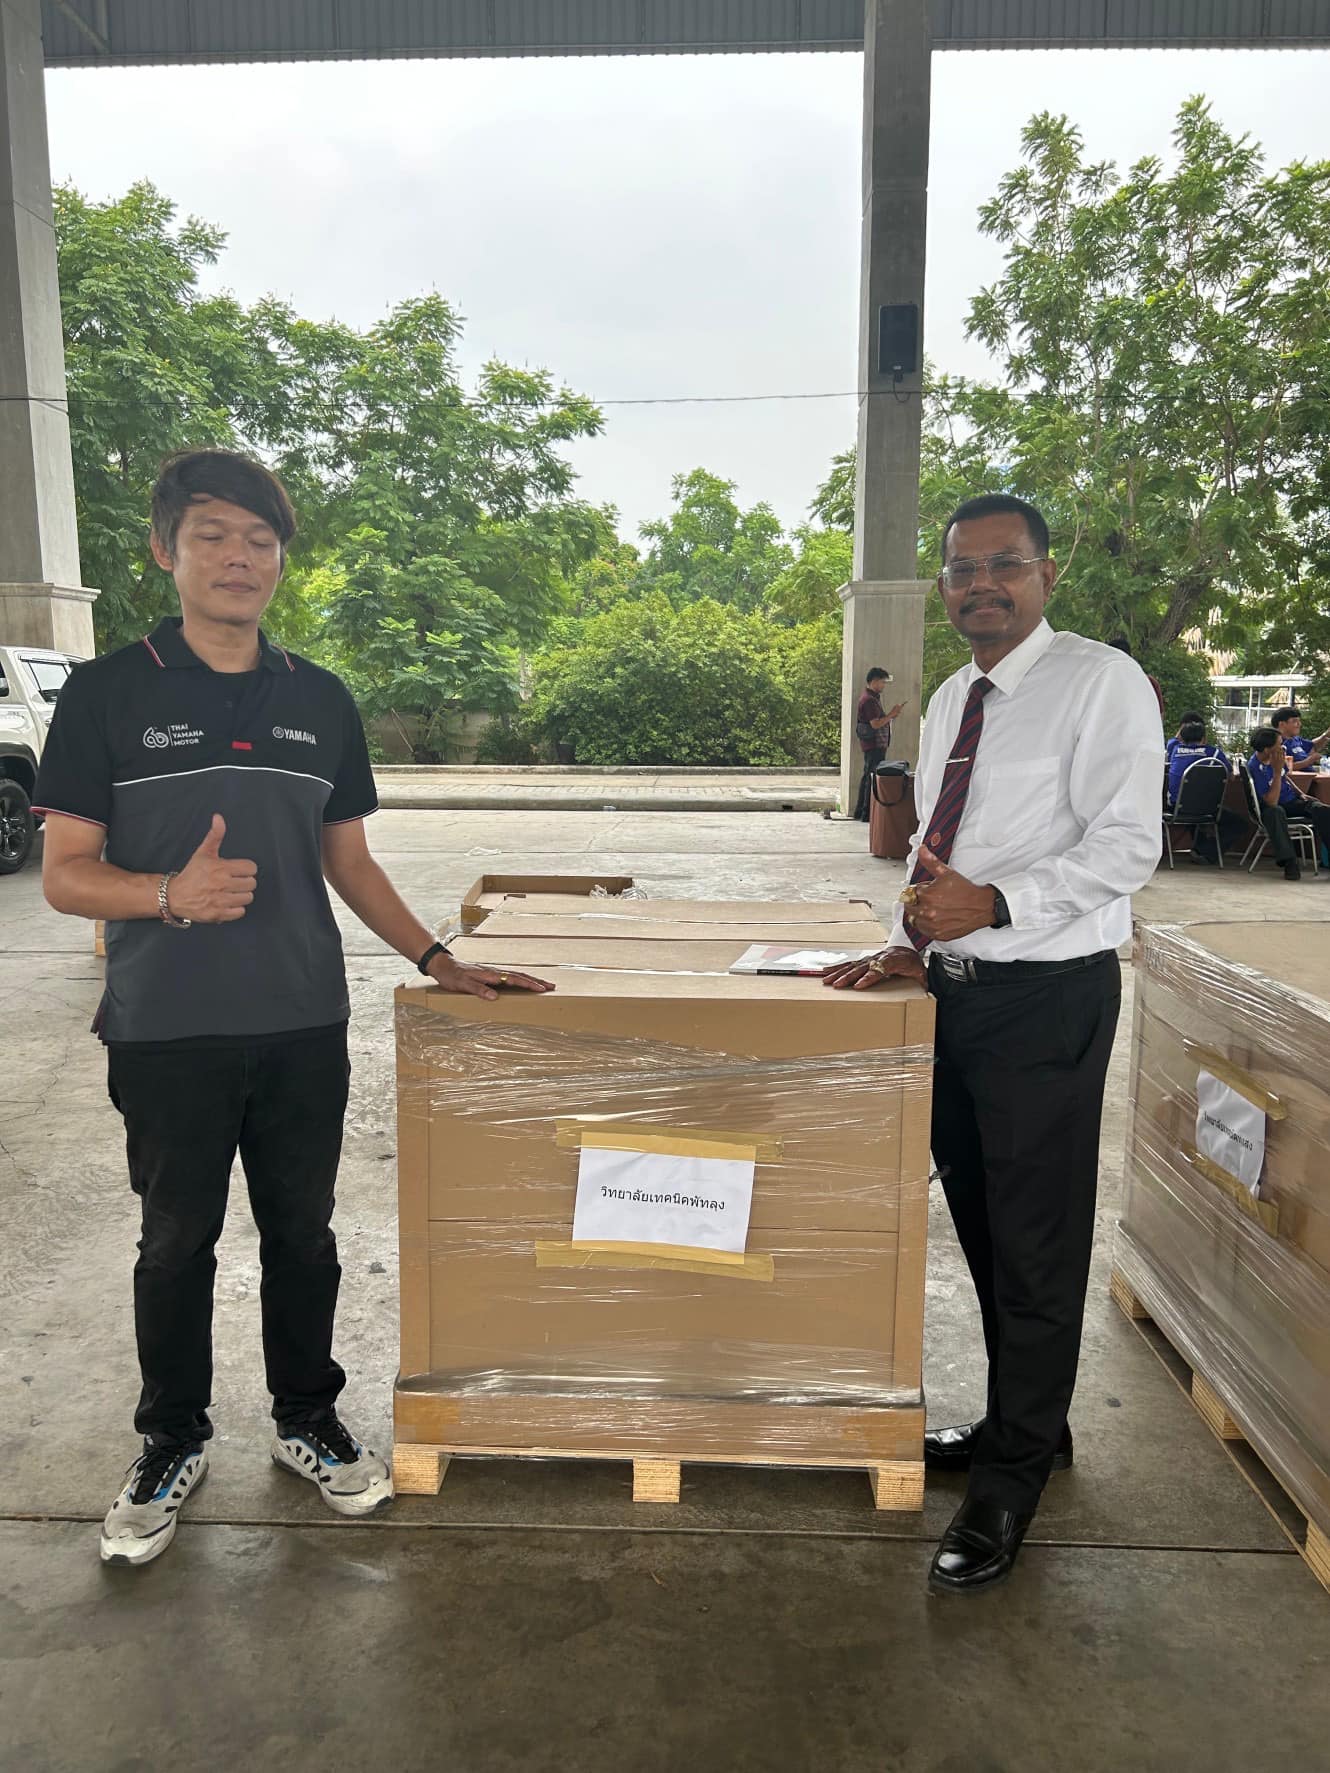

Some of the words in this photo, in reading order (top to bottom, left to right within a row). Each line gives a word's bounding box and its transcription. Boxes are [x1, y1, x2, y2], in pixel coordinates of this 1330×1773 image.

[170, 723, 189, 731] THAI
[173, 738, 200, 746] MOTOR
[284, 728, 317, 744] YAMAHA
[600, 1185, 726, 1212] วิทยาลัยเทคนิคพัทลุง
